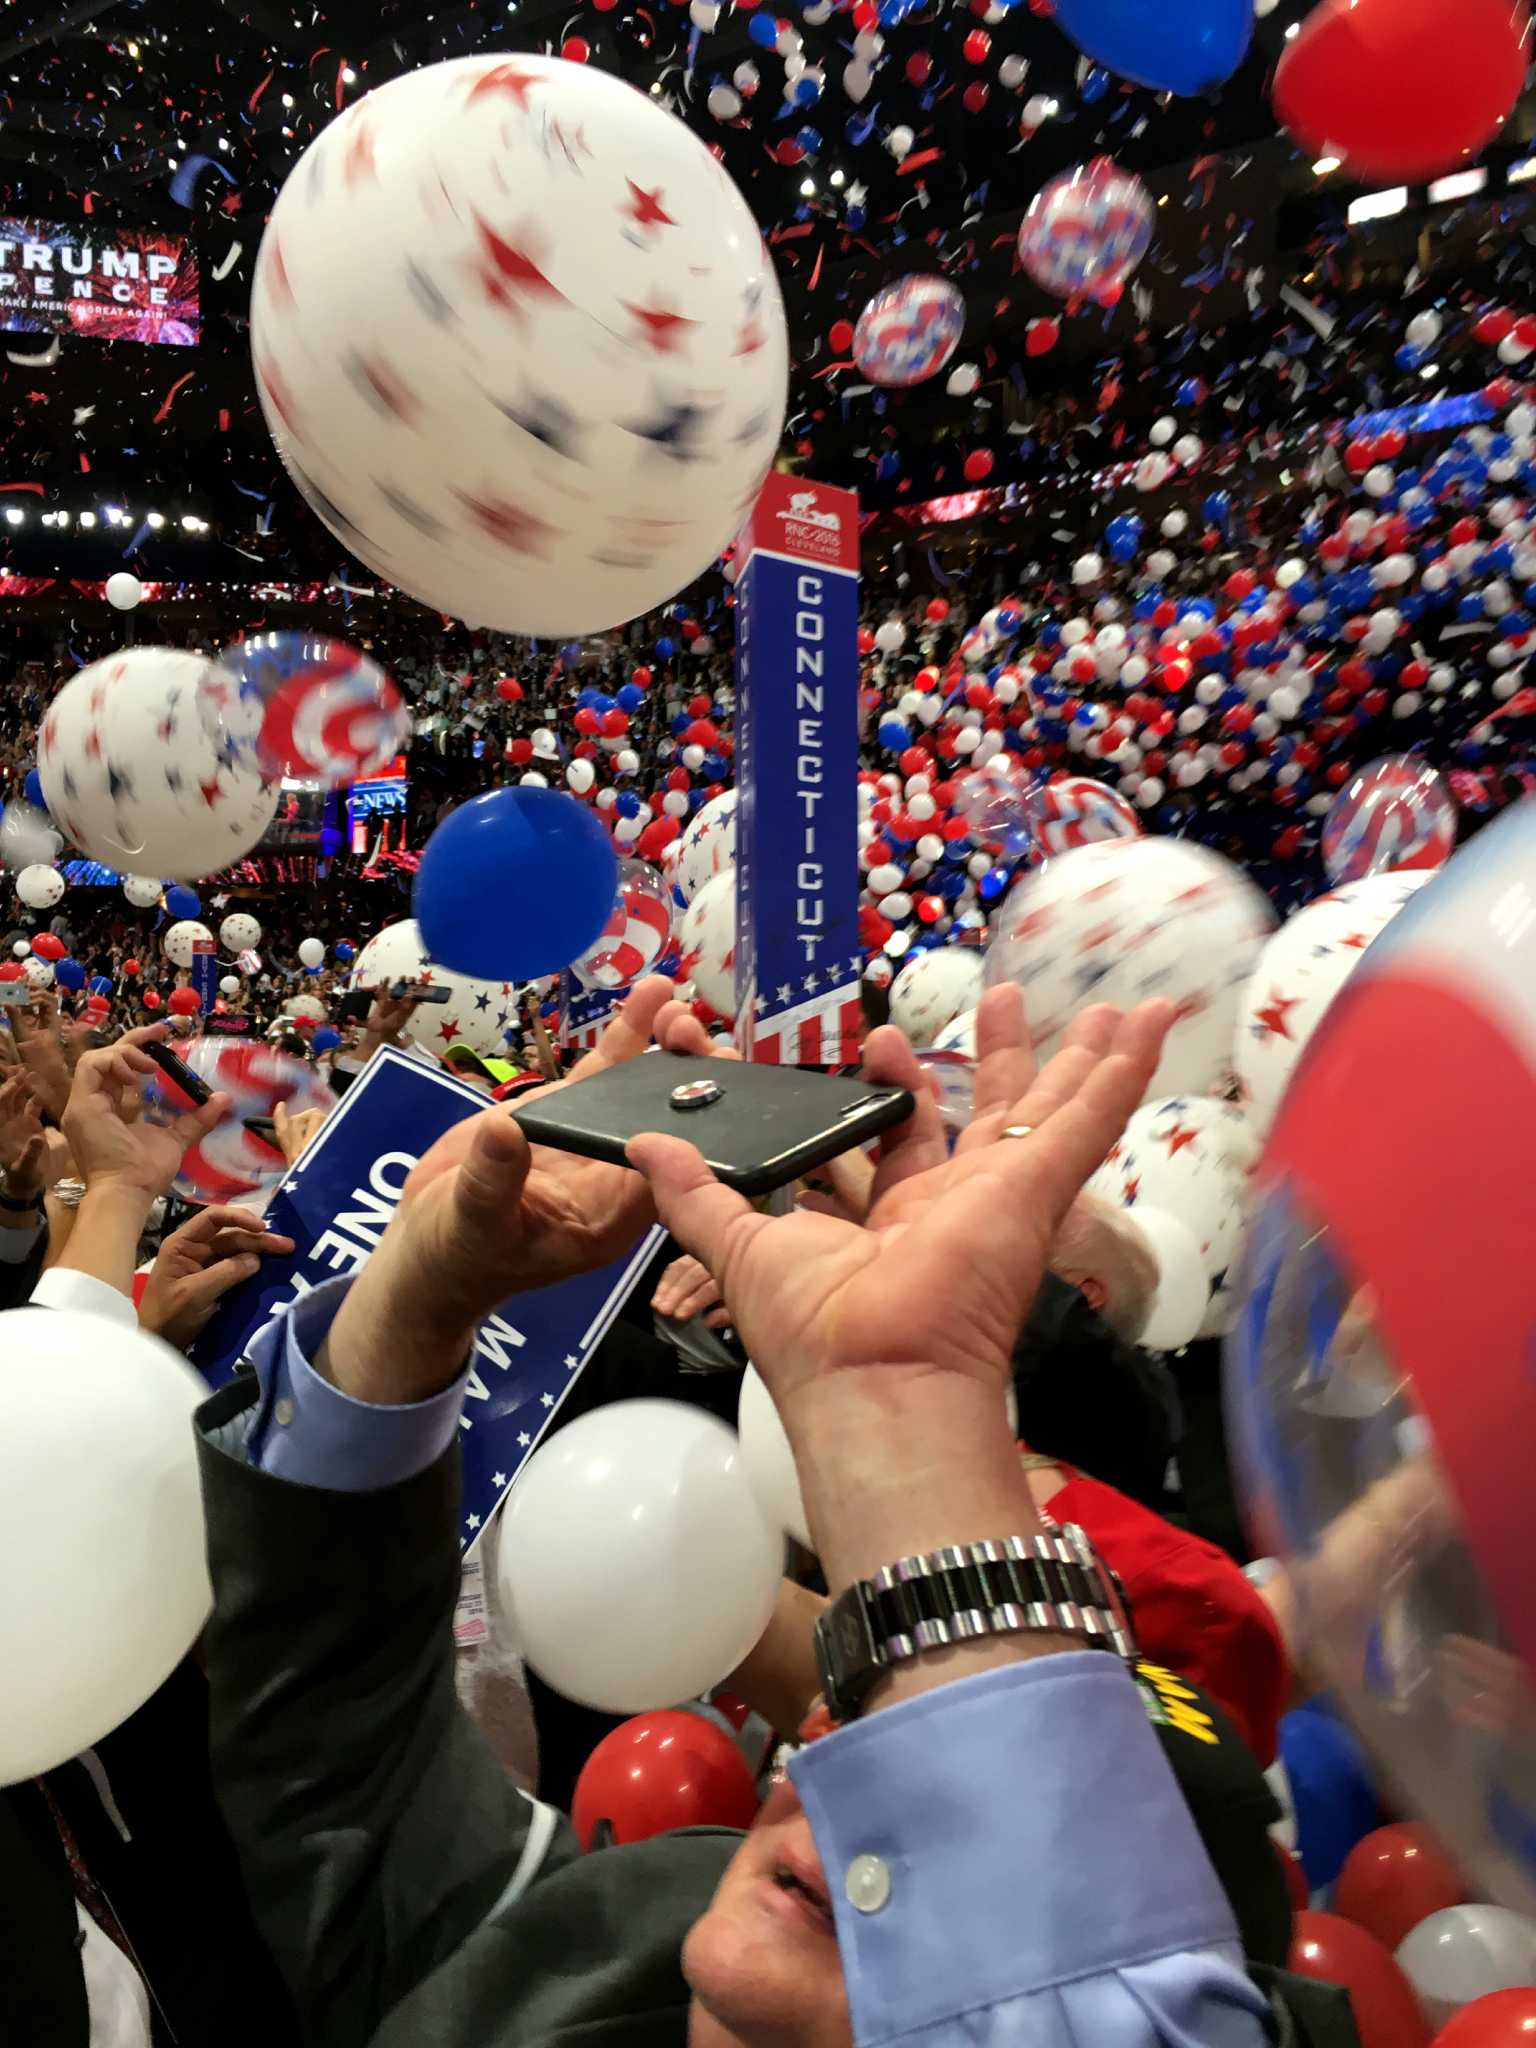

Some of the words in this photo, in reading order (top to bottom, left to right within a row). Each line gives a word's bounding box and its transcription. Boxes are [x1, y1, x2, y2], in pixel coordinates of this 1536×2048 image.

[0, 240, 177, 281] TRUMP
[0, 272, 169, 305] PENCE
[796, 575, 824, 962] CONNECTICUT
[308, 1151, 419, 1274] ONE
